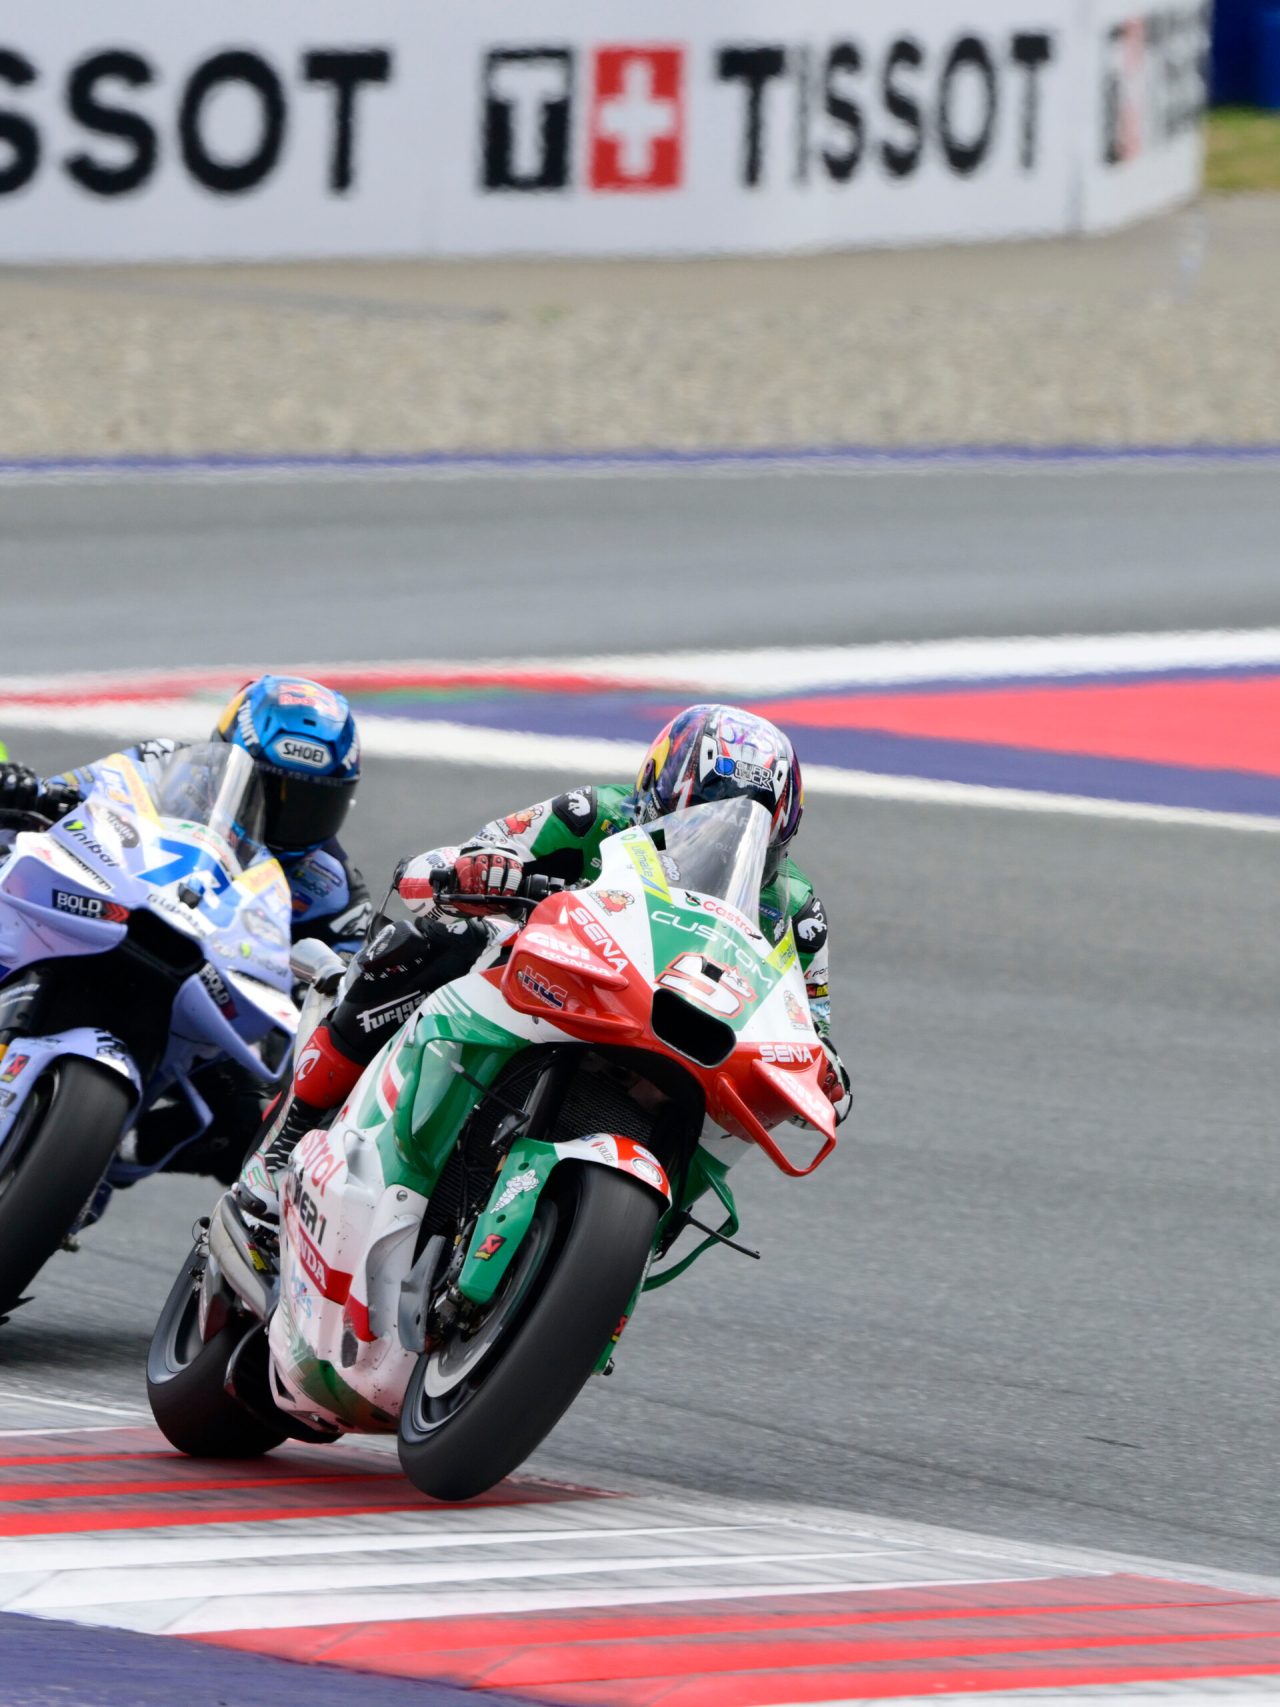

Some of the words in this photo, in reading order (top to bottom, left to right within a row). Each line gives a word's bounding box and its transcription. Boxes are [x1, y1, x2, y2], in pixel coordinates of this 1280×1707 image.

[715, 30, 1057, 188] TISSOT
[283, 742, 325, 764] SHOEI
[734, 768, 773, 792] LOCK
[735, 760, 772, 779] QUAD
[56, 890, 102, 914] BOLD
[524, 931, 591, 961] GIVI
[568, 906, 629, 973] SENA
[650, 910, 774, 990] CUSTOM
[202, 962, 230, 1005] BOLD
[655, 952, 759, 1018] 5
[758, 1044, 815, 1064] SENA
